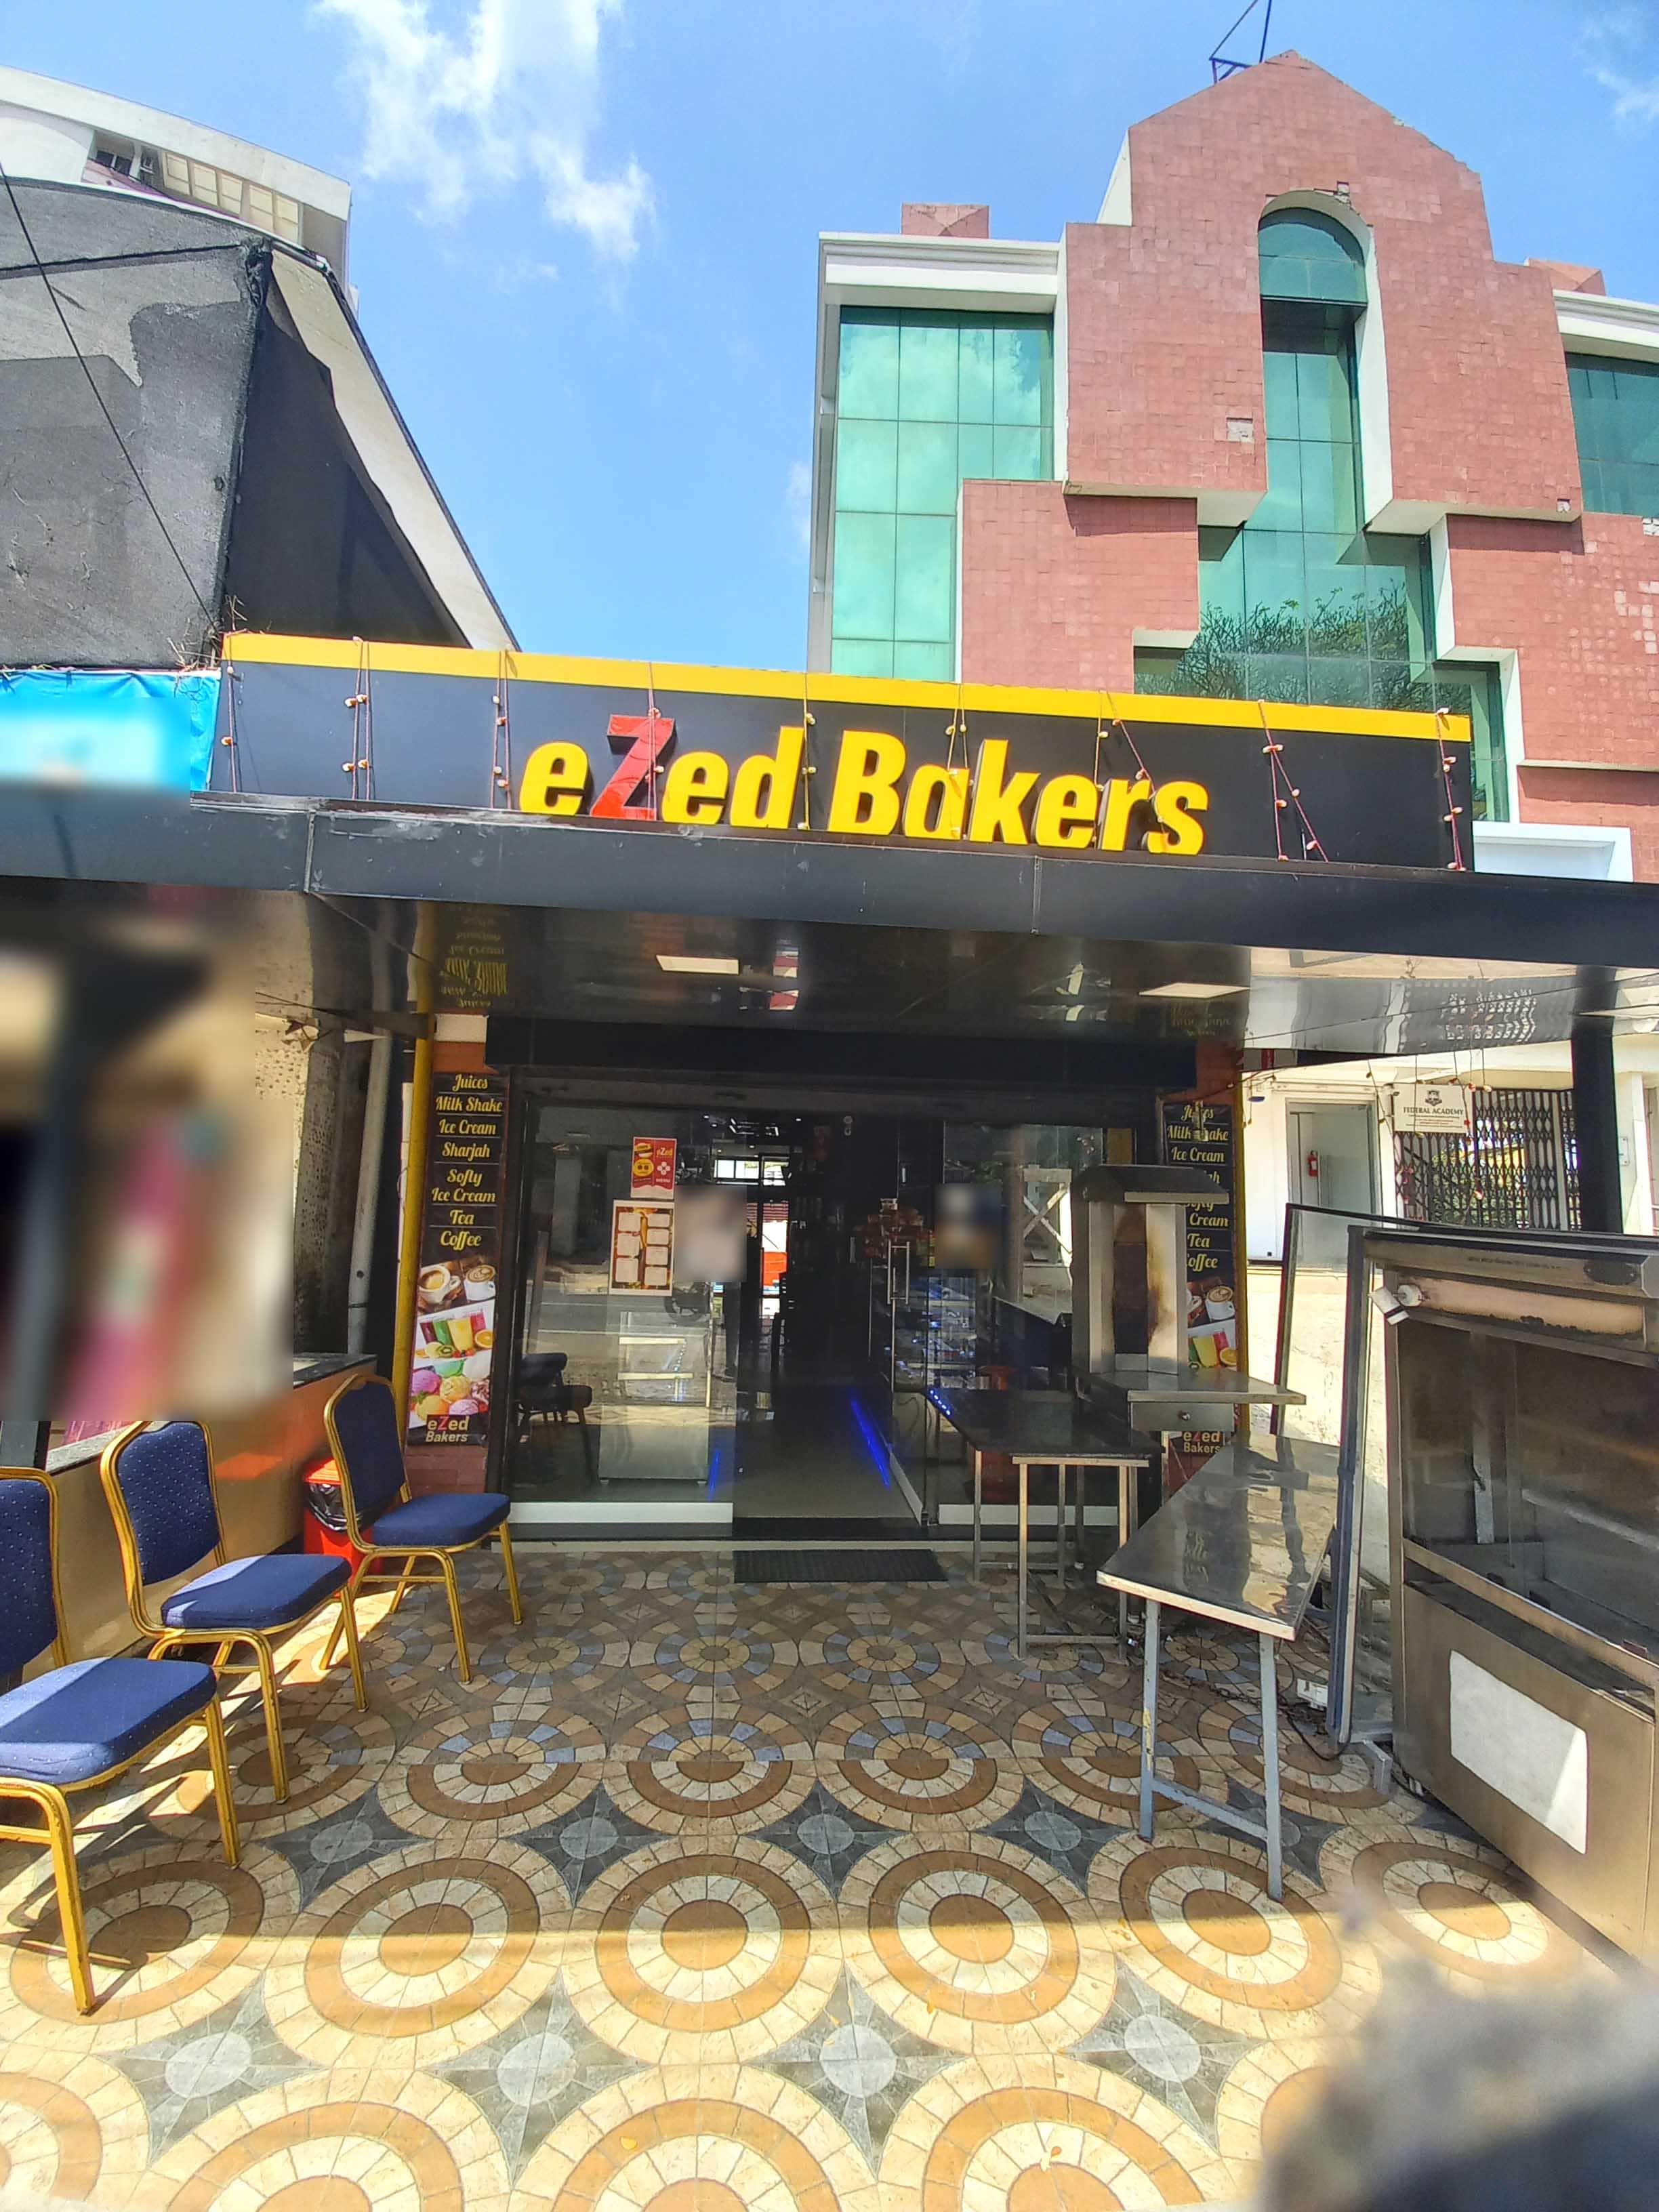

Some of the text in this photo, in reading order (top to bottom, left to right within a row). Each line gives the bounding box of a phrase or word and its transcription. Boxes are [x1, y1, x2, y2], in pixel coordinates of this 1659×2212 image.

[519, 714, 1209, 855] eZed Bakers
[452, 1073, 489, 1092] Juices
[436, 1096, 503, 1113] Milk Shake
[1404, 1106, 1464, 1115] FEDERAL ACADEMY
[439, 1119, 496, 1135] Ice Cream
[1167, 1125, 1191, 1139] Milk
[442, 1142, 491, 1162] Sharjah
[1171, 1146, 1225, 1163] Ice Cream
[432, 1187, 495, 1203] Ice Cream
[450, 1210, 474, 1225] Tea
[1189, 1212, 1229, 1227] Cream
[441, 1231, 481, 1250] Coffee
[1187, 1233, 1210, 1248] Tea
[1187, 1253, 1218, 1272] offee
[428, 1415, 470, 1431] eZed
[426, 1431, 468, 1442] Bakers
[1183, 1441, 1221, 1453] Bakers
